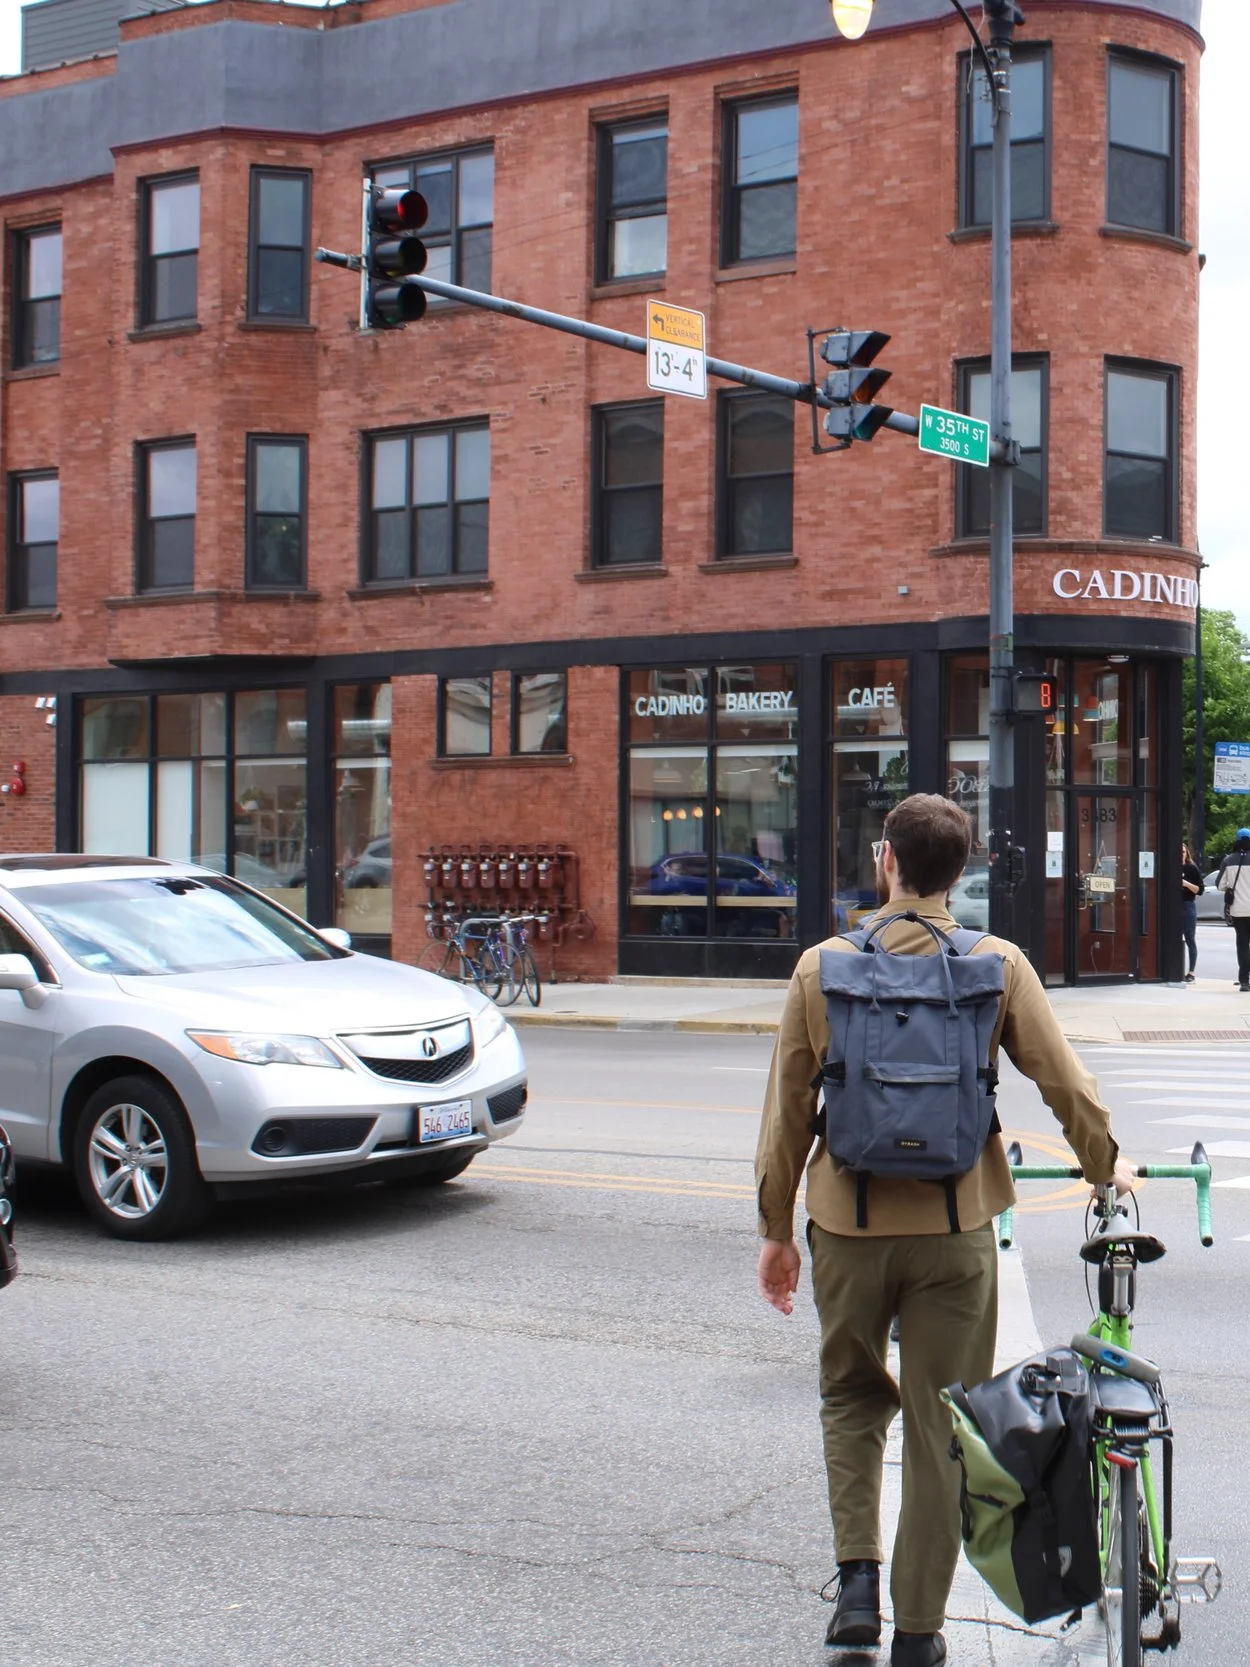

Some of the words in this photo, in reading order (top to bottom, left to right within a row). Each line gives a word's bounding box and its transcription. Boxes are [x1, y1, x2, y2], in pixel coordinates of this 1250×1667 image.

[665, 314, 695, 328] VERTICAL
[665, 326, 701, 340] CLEARANCE
[925, 414, 933, 429] W
[936, 416, 969, 436] 35TH
[972, 427, 985, 443] ST
[940, 437, 960, 453] 3500
[963, 443, 969, 455] S
[1053, 569, 1198, 608] CADINHO
[635, 695, 704, 716] CADINHO
[726, 691, 793, 712] BAKERY
[848, 682, 894, 707] CAFÉ
[1041, 683, 1050, 708] 8
[1082, 808, 1117, 822] 383
[1094, 881, 1111, 889] OPEN
[424, 1116, 442, 1135] 546
[447, 1111, 470, 1131] 2465
